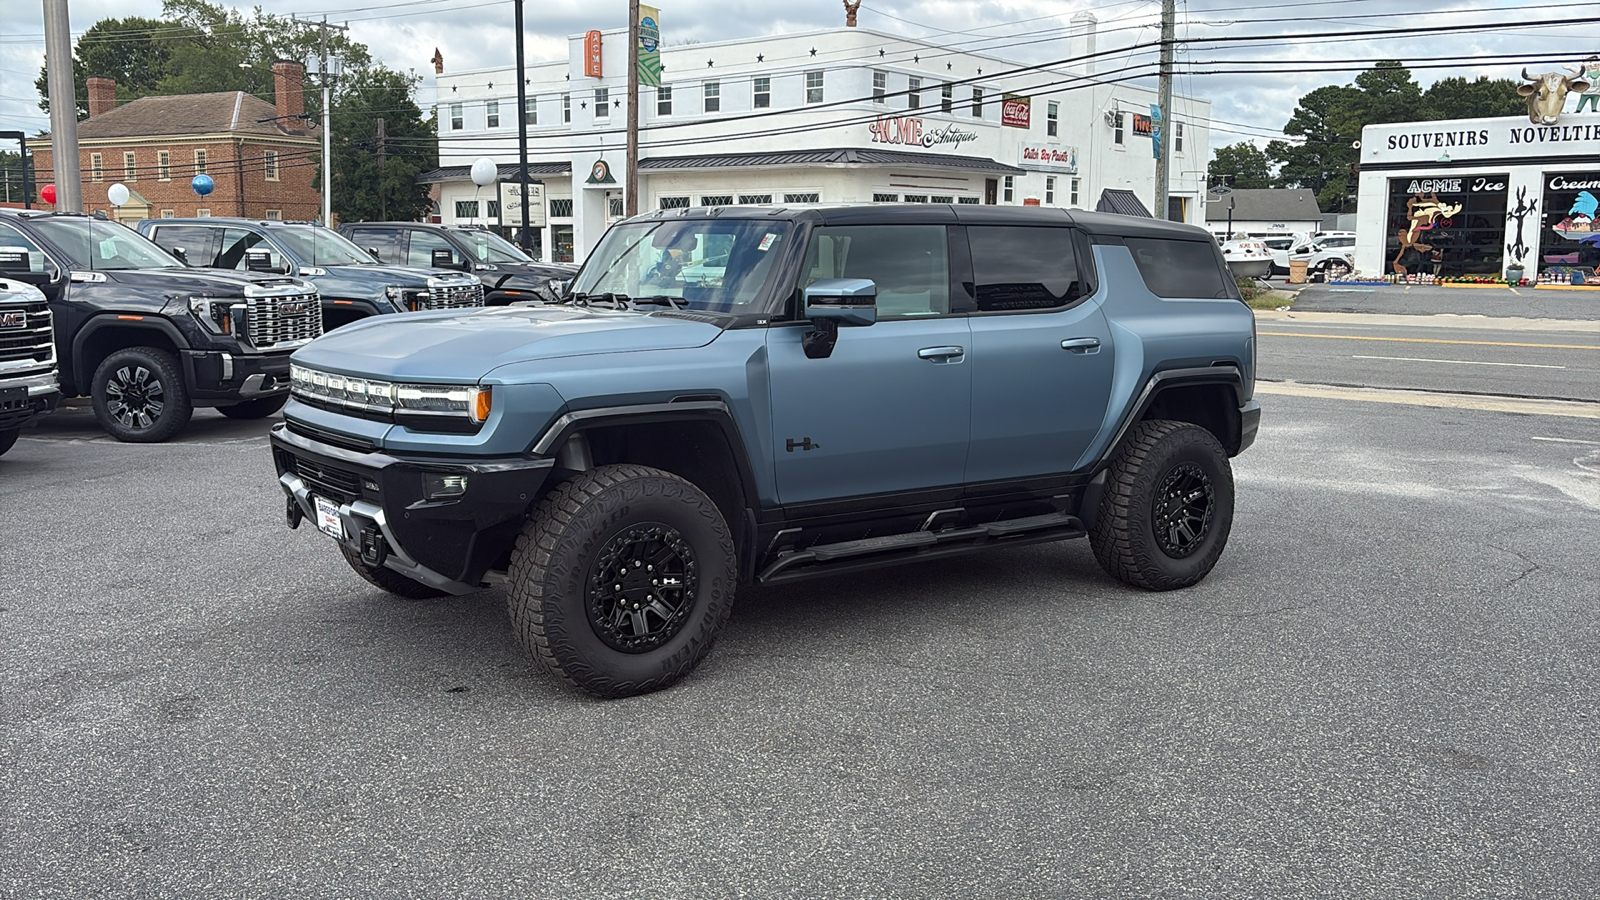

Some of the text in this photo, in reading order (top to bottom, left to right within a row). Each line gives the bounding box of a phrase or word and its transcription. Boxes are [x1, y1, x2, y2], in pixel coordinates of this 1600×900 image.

[592, 34, 600, 74] ACME
[869, 115, 978, 149] ACME Antiques
[1387, 124, 1600, 150] SOUVENIRS NOVELTIE
[1023, 147, 1068, 163] Dutch Boy Paints
[1407, 177, 1505, 193] ACME Ice
[1549, 175, 1600, 190] Cream
